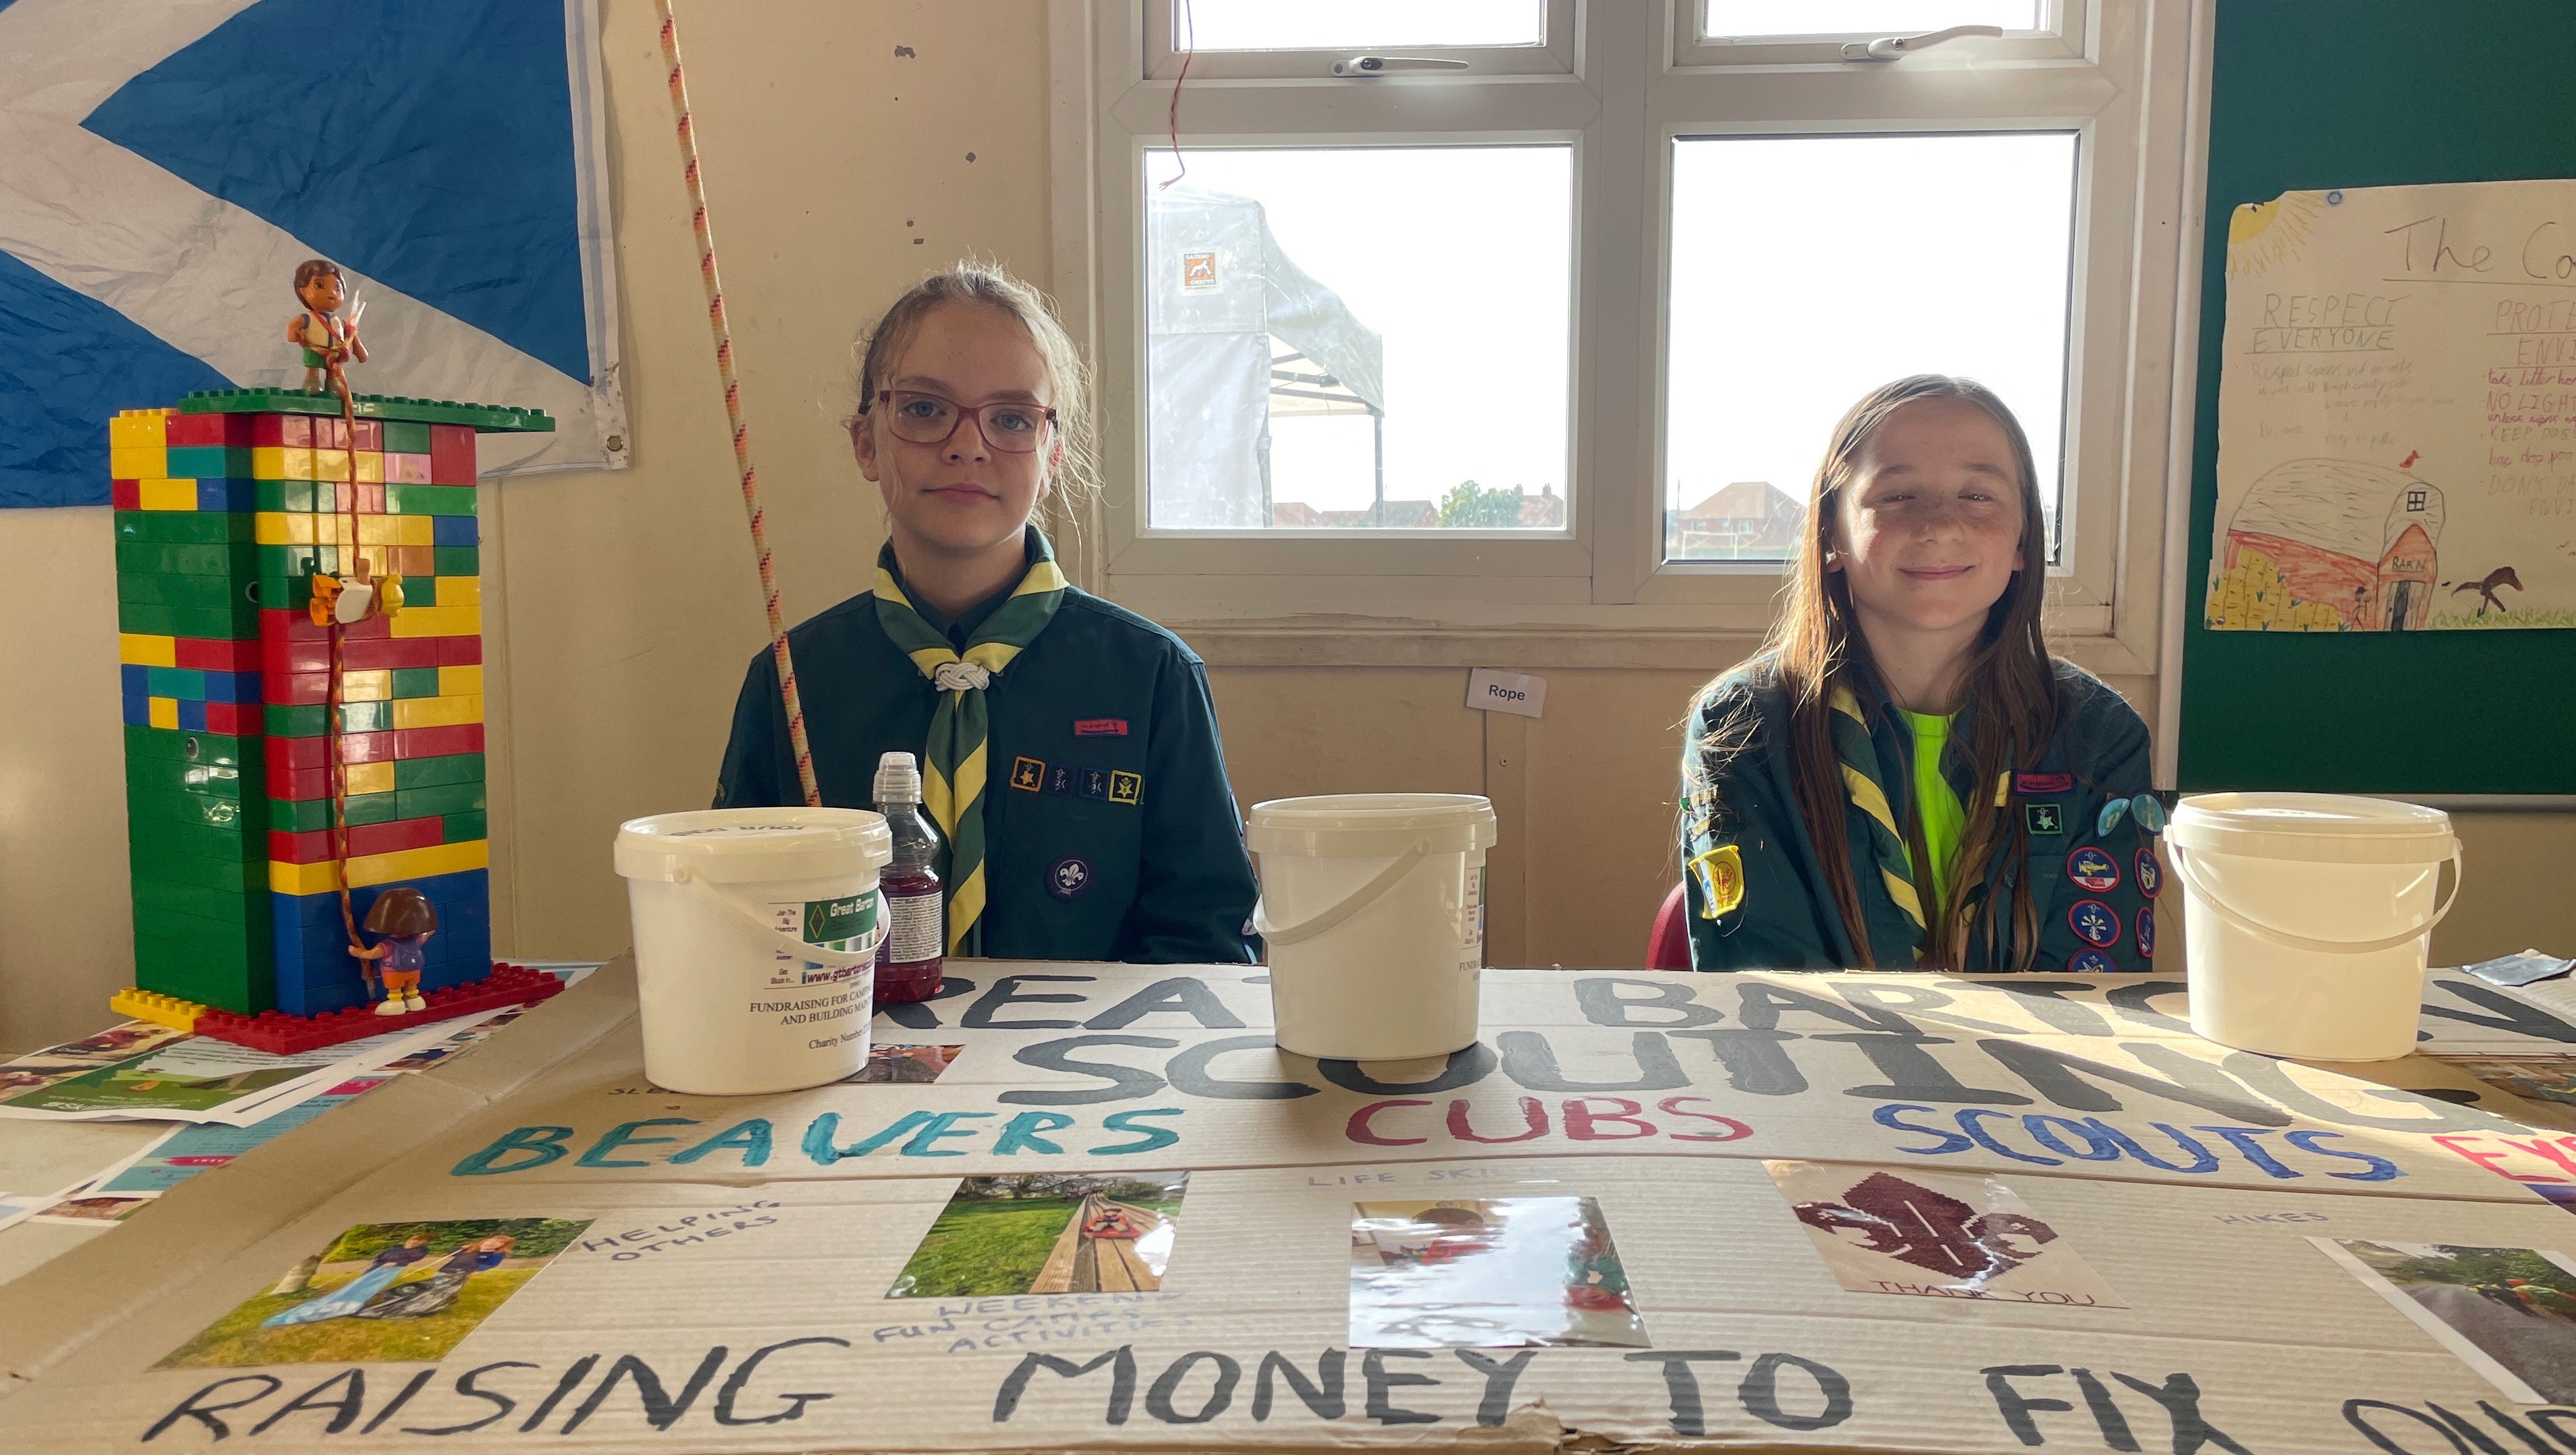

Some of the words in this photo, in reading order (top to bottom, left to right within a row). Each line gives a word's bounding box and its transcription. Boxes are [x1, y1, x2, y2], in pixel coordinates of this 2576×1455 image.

[2384, 216, 2493, 272] The
[2264, 293, 2411, 327] RESPECT
[2252, 327, 2395, 353] EVERYONE
[2487, 390, 2510, 412] NO
[1489, 684, 1526, 701] Rope
[830, 902, 854, 917] Great
[855, 897, 874, 913] Barton
[749, 997, 829, 1012] FUNDRAISING
[831, 994, 848, 1006] FOR
[780, 1014, 806, 1026] AND
[808, 1006, 854, 1023] BUILDING
[808, 1035, 839, 1049] Charity
[840, 1029, 862, 1043] Number
[1346, 1097, 1754, 1146] CUBS
[450, 1108, 1185, 1176] BEAVERS
[1873, 1104, 2404, 1182] SCOUTS
[1308, 1172, 1397, 1186] LIFE
[582, 1200, 781, 1252] HELPING
[2212, 1212, 2329, 1225] HIKES
[611, 1216, 778, 1261] OTHERS
[940, 1289, 1184, 1317] WEEKEND
[1869, 1280, 1997, 1300] THANK
[2011, 1289, 2096, 1305] YOU
[873, 1318, 956, 1343] FUN
[983, 1308, 1141, 1332] CAMPS
[947, 1314, 1193, 1354] ACTIVITIES
[141, 1337, 851, 1443] RAISING
[993, 1344, 1538, 1428] MONEY
[1625, 1350, 1854, 1436] TO
[1979, 1364, 2255, 1455] FIX
